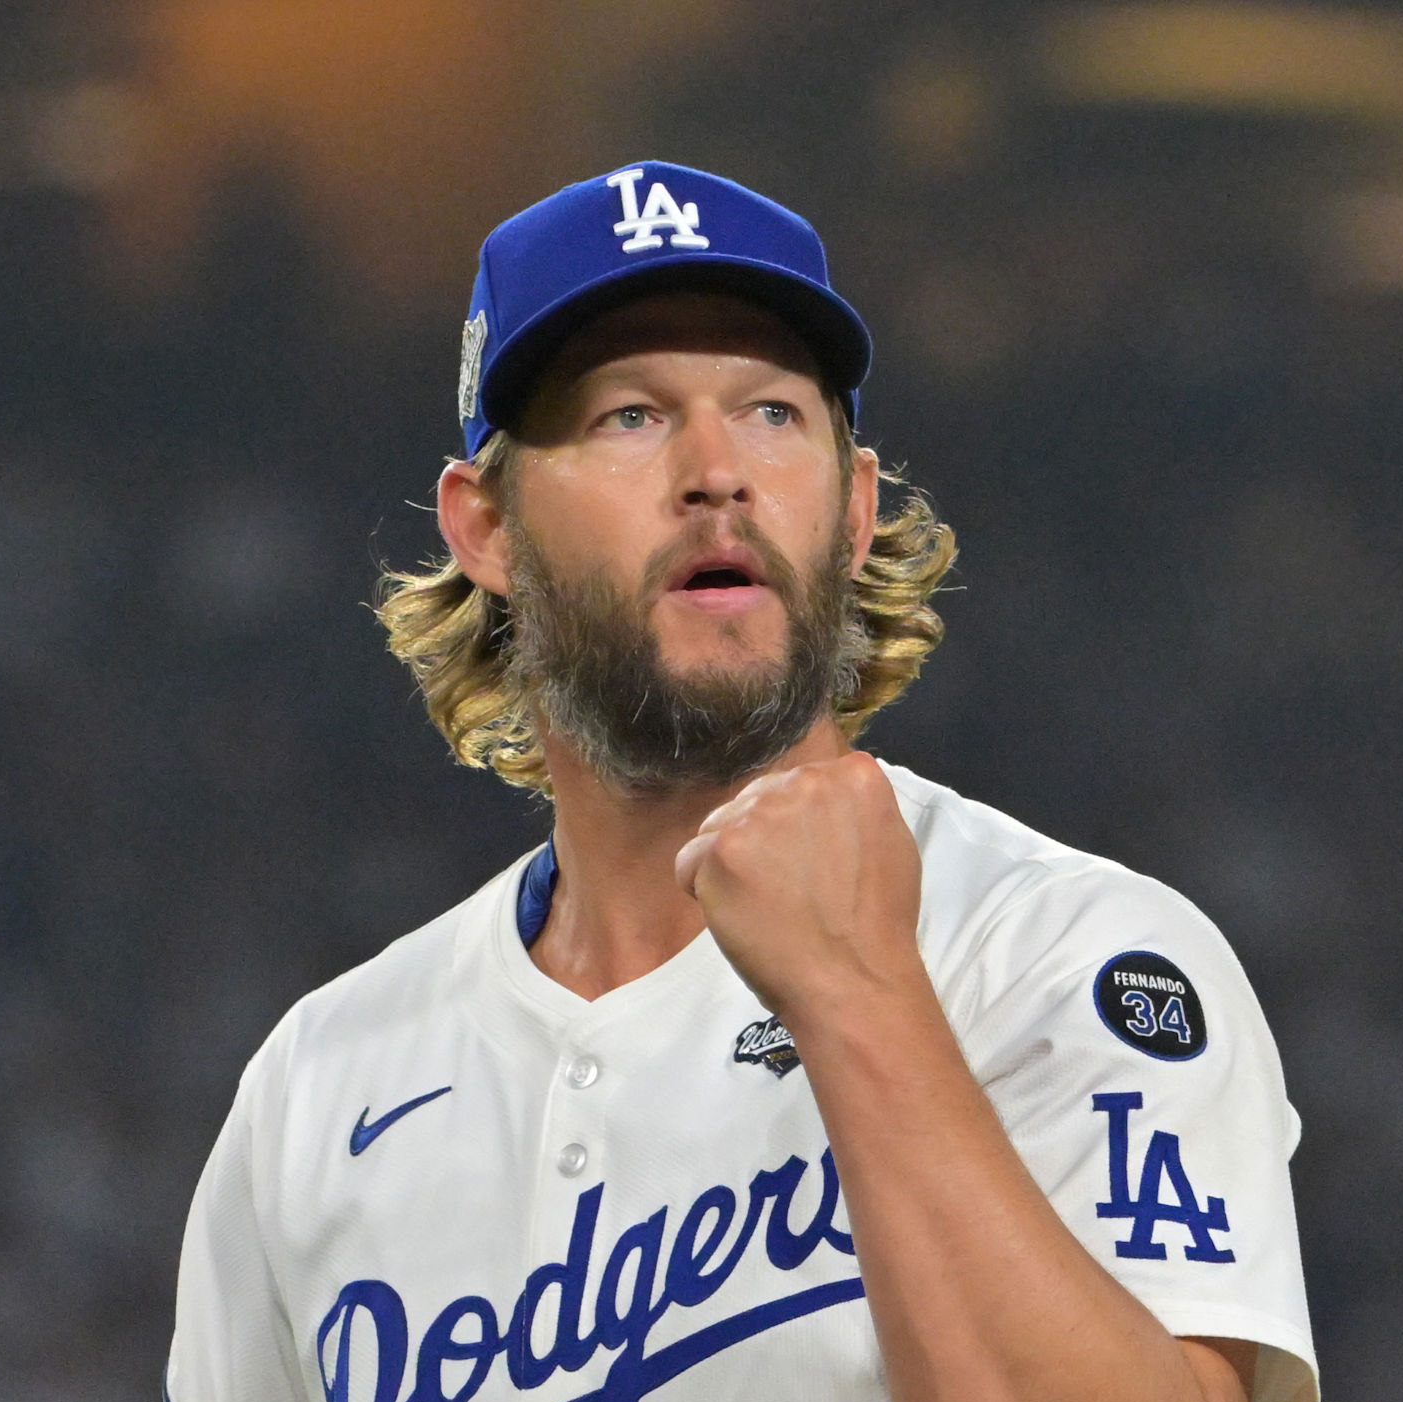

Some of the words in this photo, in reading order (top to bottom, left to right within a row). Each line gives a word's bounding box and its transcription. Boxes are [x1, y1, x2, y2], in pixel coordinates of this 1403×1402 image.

[606, 168, 710, 254] LA
[1113, 971, 1186, 995] FERNANDO
[1121, 990, 1191, 1044] 34
[1091, 1091, 1236, 1264] LA
